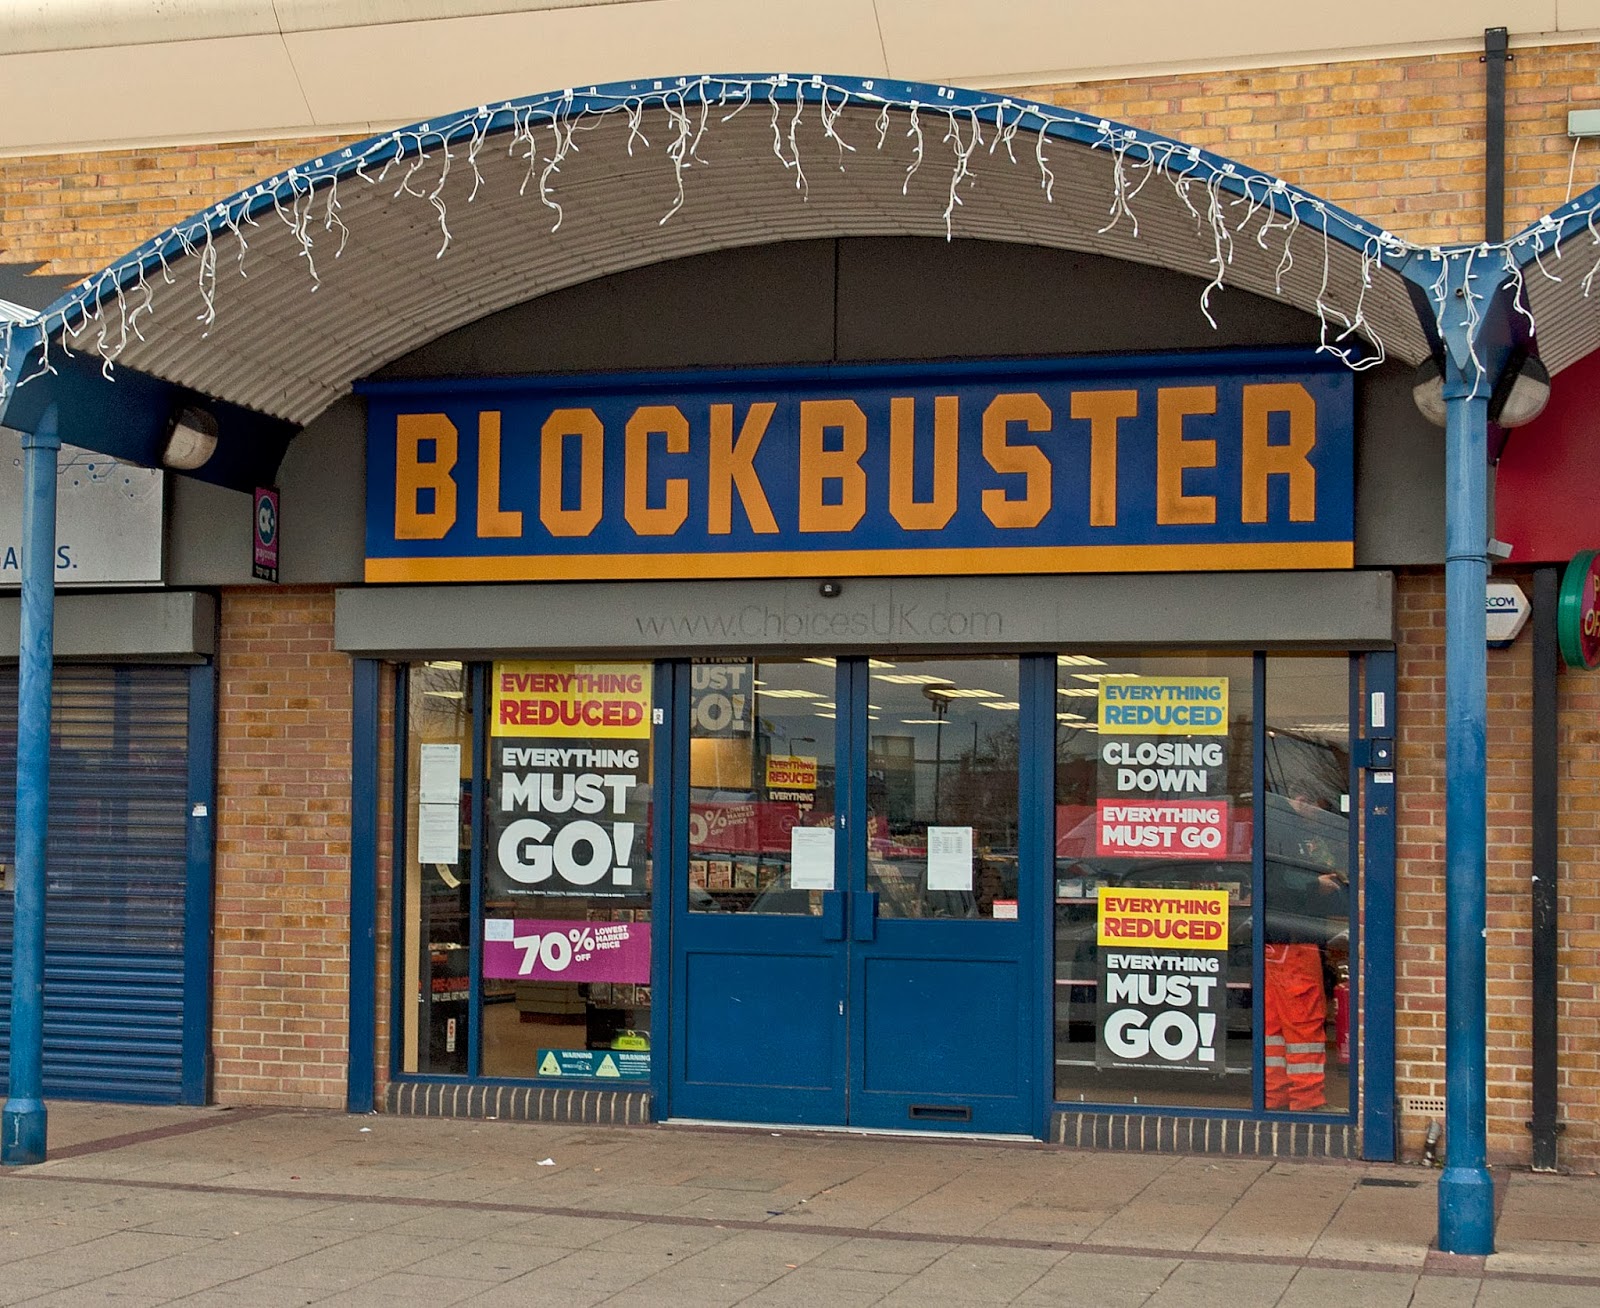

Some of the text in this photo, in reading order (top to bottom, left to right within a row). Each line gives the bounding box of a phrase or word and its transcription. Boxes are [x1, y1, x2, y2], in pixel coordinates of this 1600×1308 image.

[394, 382, 1316, 540] BLOCKBUSTER
[501, 673, 643, 694] EVERYTHING
[691, 667, 746, 690] UST
[1105, 685, 1221, 701] EVERYTHING
[502, 747, 640, 769] EVERYTHING
[1102, 742, 1223, 767] CLOSING
[769, 760, 814, 770] EVERYTHING
[768, 771, 815, 784] REDUCED
[1117, 768, 1208, 792] DOWN
[502, 772, 637, 815] MUST
[769, 791, 814, 802] EVERYTHING
[726, 805, 753, 814] LOWEST
[727, 811, 755, 820] MARKED
[1103, 806, 1220, 824] EVERYTHING
[690, 809, 727, 845] 0%
[728, 818, 747, 826] PRICE
[1103, 825, 1222, 849] MUST GO
[498, 818, 635, 886] GO!
[1105, 897, 1221, 916] EVERYTHING
[594, 924, 628, 936] LOWEST
[595, 932, 630, 944] MARKED
[513, 927, 596, 976] 70%
[596, 940, 621, 951] PRICE
[575, 953, 591, 962] OFF
[1107, 953, 1220, 973] EVERYTHING
[1106, 972, 1218, 1008] MUST
[1104, 1008, 1217, 1062] GO!
[561, 1051, 593, 1060] WARNING
[619, 1053, 651, 1063] WARNING
